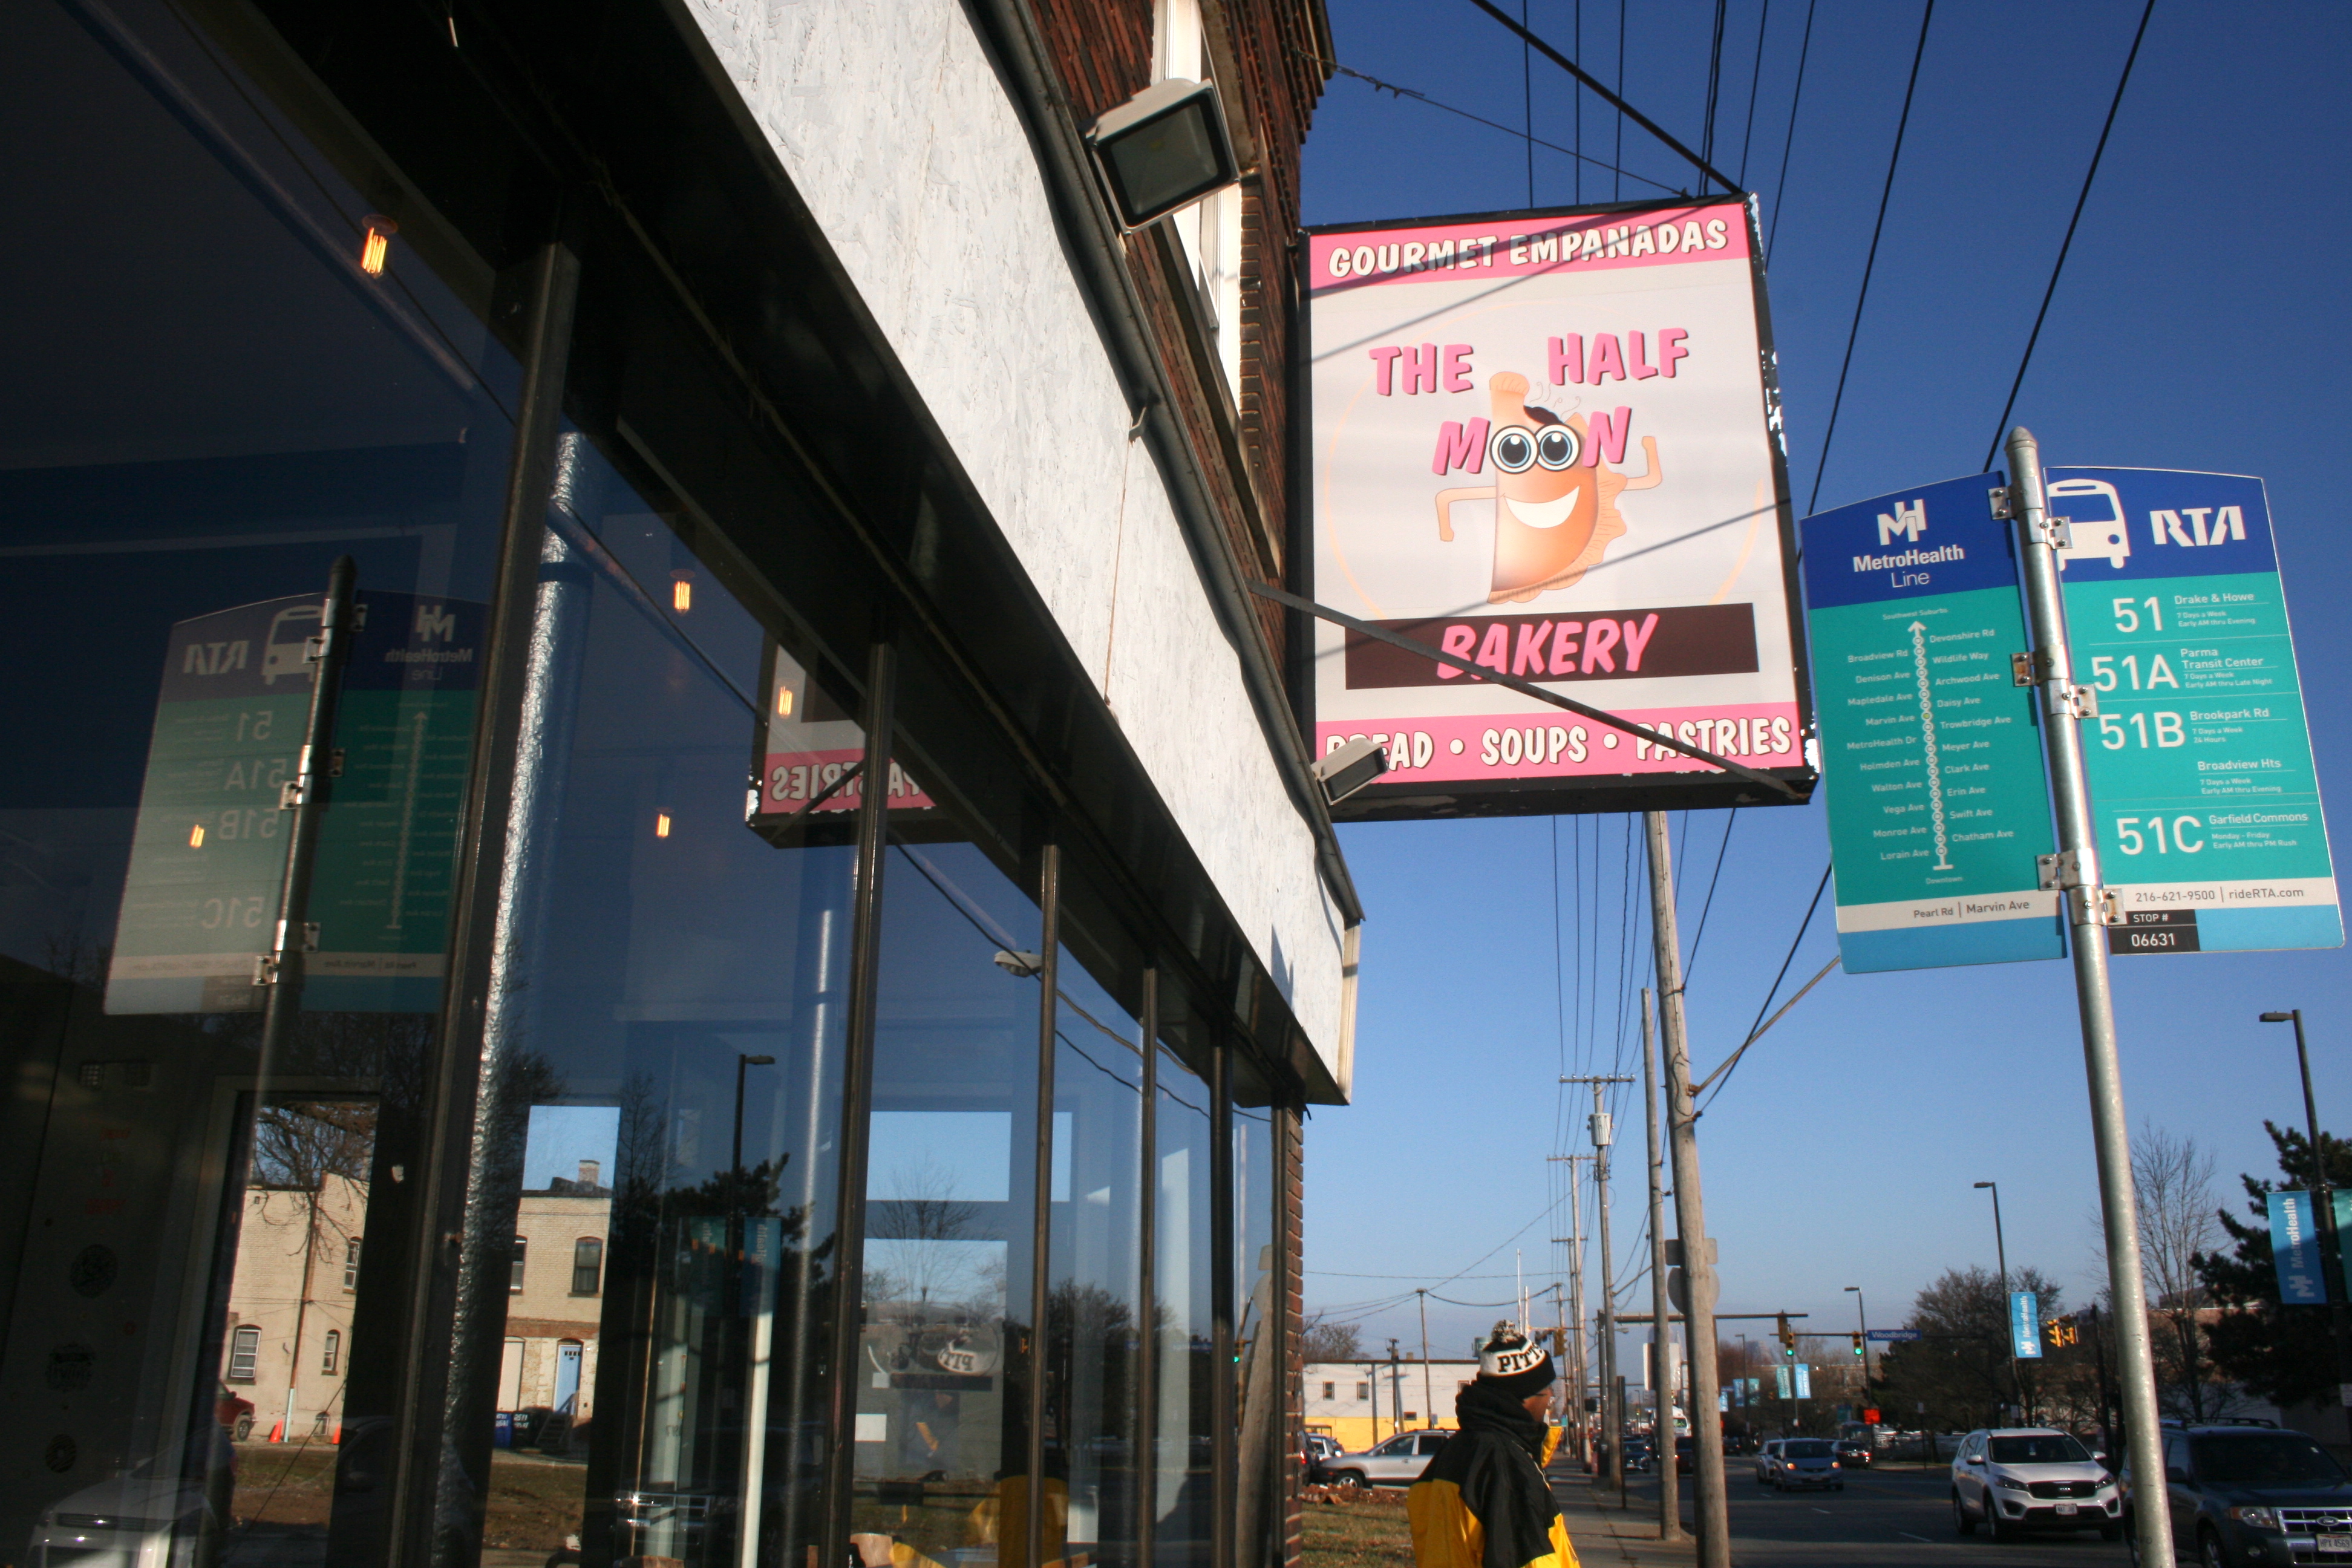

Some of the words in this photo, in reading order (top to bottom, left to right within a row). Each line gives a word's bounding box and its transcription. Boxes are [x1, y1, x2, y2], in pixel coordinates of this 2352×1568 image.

[1328, 235, 1497, 278] GOURMET
[1510, 218, 1727, 265] EMPANADAS
[1369, 343, 1474, 396] THE
[1548, 328, 1690, 386] HALF
[2150, 506, 2246, 547] RTA
[1853, 545, 1965, 572] MetroHealth
[1892, 572, 1930, 588] Line
[2174, 595, 2208, 604] Drake
[2211, 593, 2221, 603] &
[2223, 593, 2255, 602] Howe
[1883, 610, 1918, 620] Southwest
[1919, 607, 1949, 616] Suburbs
[2112, 596, 2163, 633] 51
[1929, 630, 1980, 643] Devonshire
[1982, 629, 1996, 637] Rd
[1437, 613, 1659, 680] BAKERY
[1847, 652, 1894, 662] Broadview
[1933, 654, 1967, 664] Wildlife
[1969, 652, 1990, 661] Way
[2180, 648, 2218, 658] Parma
[2182, 659, 2223, 668] Transit
[2225, 658, 2264, 667] Center
[1856, 673, 1892, 683] Denison
[2091, 654, 2180, 691] 51A
[1936, 675, 1981, 685] Archwood
[1848, 695, 1894, 706] Mapledale
[1937, 698, 1962, 708] Daisy
[2190, 709, 2251, 720] Brookpark
[2253, 708, 2270, 717] Rd
[1866, 716, 1896, 726] Marvin
[1941, 718, 1992, 729] Trowbridge
[2099, 711, 2185, 750] 51B
[1480, 725, 1588, 766] SOUPS
[1636, 716, 1791, 761] PASTRIES
[1847, 737, 1903, 750] MetroHealth
[1942, 743, 1970, 752] Meyer
[1860, 760, 1901, 771] Holmden
[1945, 765, 1970, 774] Clark
[2197, 760, 2258, 771] Broadview
[2261, 759, 2282, 768] Hts
[1872, 782, 1904, 792] Walton
[1947, 788, 1966, 797] Erin
[1883, 805, 1906, 814] Vega
[1950, 810, 1973, 819] Swift
[2209, 814, 2252, 824] Garfield
[2253, 813, 2308, 823] Commons
[1873, 828, 1908, 837] Monroe
[1952, 832, 1994, 841] Chatham
[2117, 815, 2204, 855] 51C
[1880, 851, 1910, 860] Lorain
[2136, 890, 2215, 903] 216-621-9500
[2229, 888, 2304, 900] rideRTA.com
[1914, 908, 1938, 918] Pearl
[1941, 907, 1953, 915] Rd
[1966, 901, 2005, 914] Marvin
[2008, 900, 2030, 910] Ave
[2134, 914, 2159, 923] STOP
[2162, 913, 2169, 922] #
[2131, 933, 2175, 947] 06631
[2283, 1197, 2304, 1269] MetroHealth
[1872, 1331, 1918, 1339] Woodbridge
